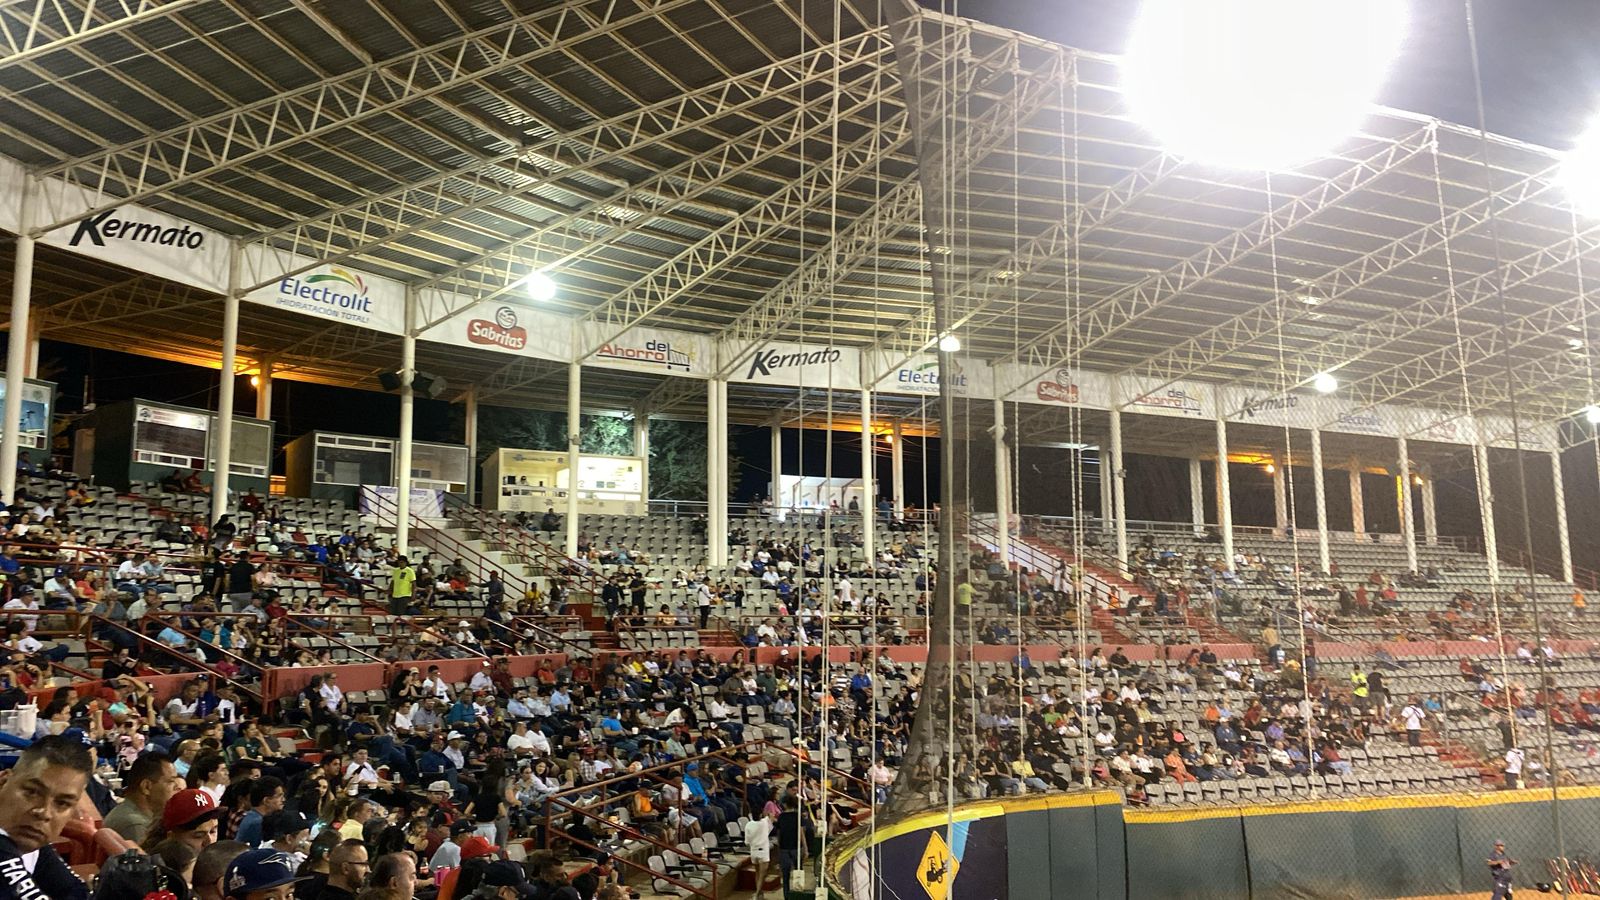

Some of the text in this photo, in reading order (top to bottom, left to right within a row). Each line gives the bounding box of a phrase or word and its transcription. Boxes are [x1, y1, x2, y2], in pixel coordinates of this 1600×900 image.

[69, 208, 204, 250] Kermato
[280, 277, 373, 313] Electrolit
[471, 322, 524, 349] Sabritas
[600, 343, 665, 361] Ahorro
[746, 347, 841, 380] Kermato
